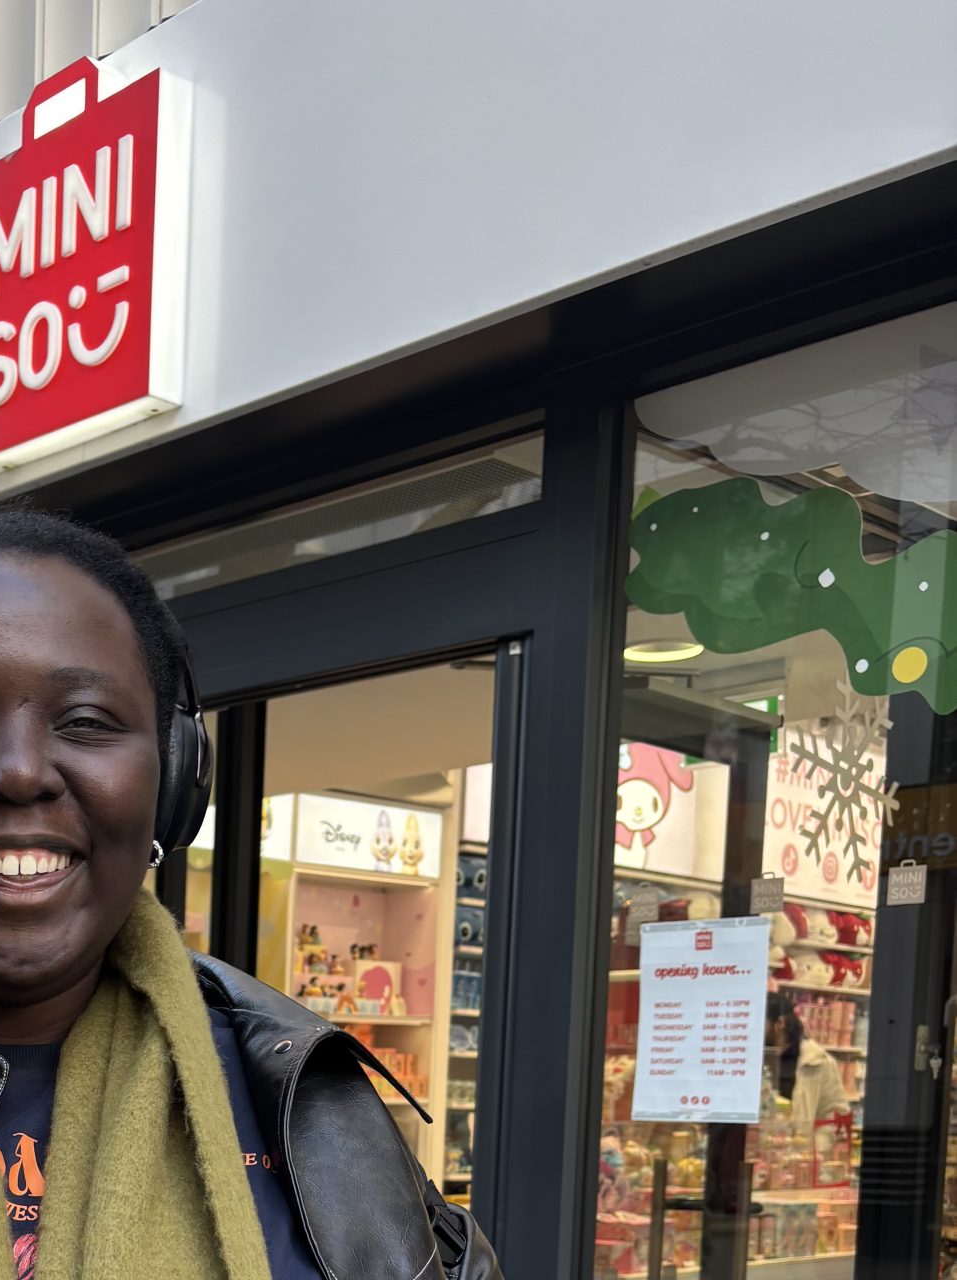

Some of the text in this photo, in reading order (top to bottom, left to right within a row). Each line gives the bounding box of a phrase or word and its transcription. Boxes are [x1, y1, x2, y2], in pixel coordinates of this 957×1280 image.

[891, 871, 924, 886] MINI
[654, 962, 751, 980] opening hours...
[242, 1152, 258, 1167] E
